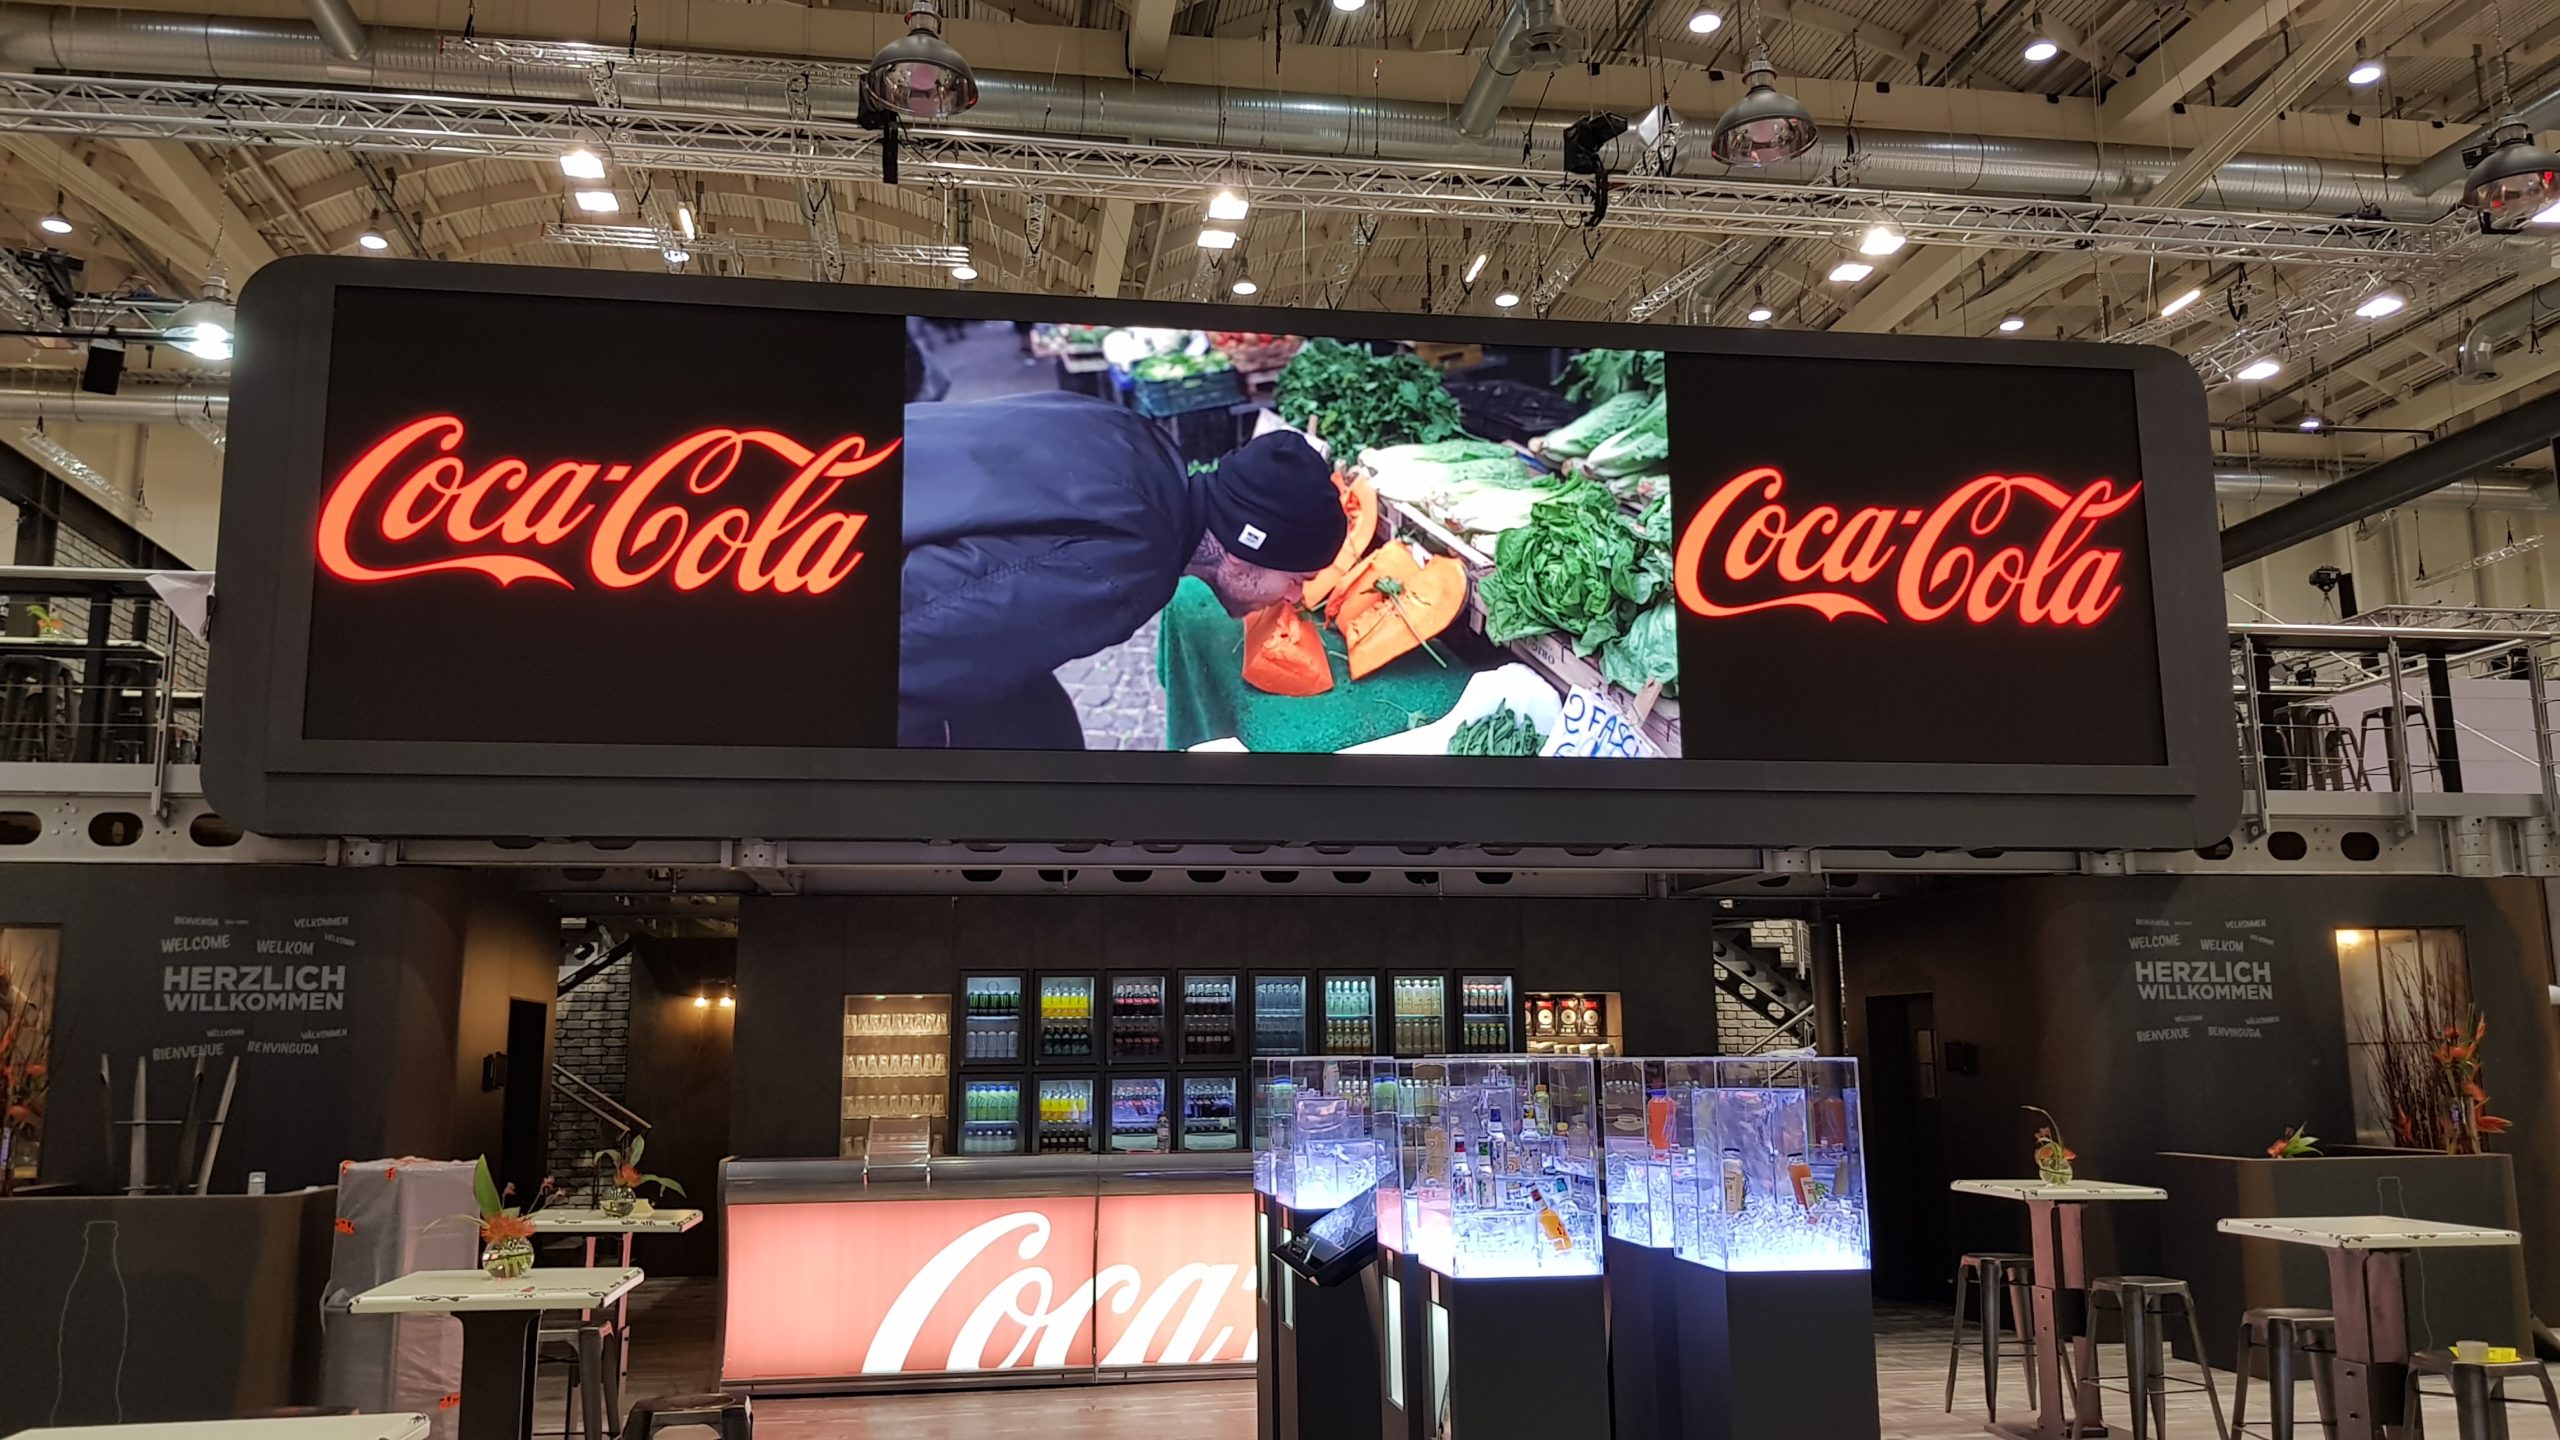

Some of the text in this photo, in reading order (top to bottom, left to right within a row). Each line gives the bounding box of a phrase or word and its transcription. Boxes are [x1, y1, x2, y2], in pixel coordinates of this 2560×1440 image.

[317, 415, 902, 594] Coca-Cola
[1674, 467, 2142, 624] Coca-Cola
[294, 916, 349, 928] VELKOMMEN
[161, 934, 231, 953] WELCOME
[256, 939, 314, 955] WELKOM
[2128, 934, 2181, 950] WELCOME
[2200, 939, 2244, 952] WELKOM
[163, 965, 346, 991] HERZLICH
[2135, 961, 2271, 983] HERZLICH
[2137, 984, 2273, 1000] WILLKOMMEN
[163, 992, 344, 1011] WILLKOMMEN
[2136, 1027, 2191, 1043] BIENVENUE
[153, 1043, 225, 1061] BIENVENUE
[248, 1041, 320, 1055] BENVINGUDA
[862, 1211, 1257, 1373] Coca
